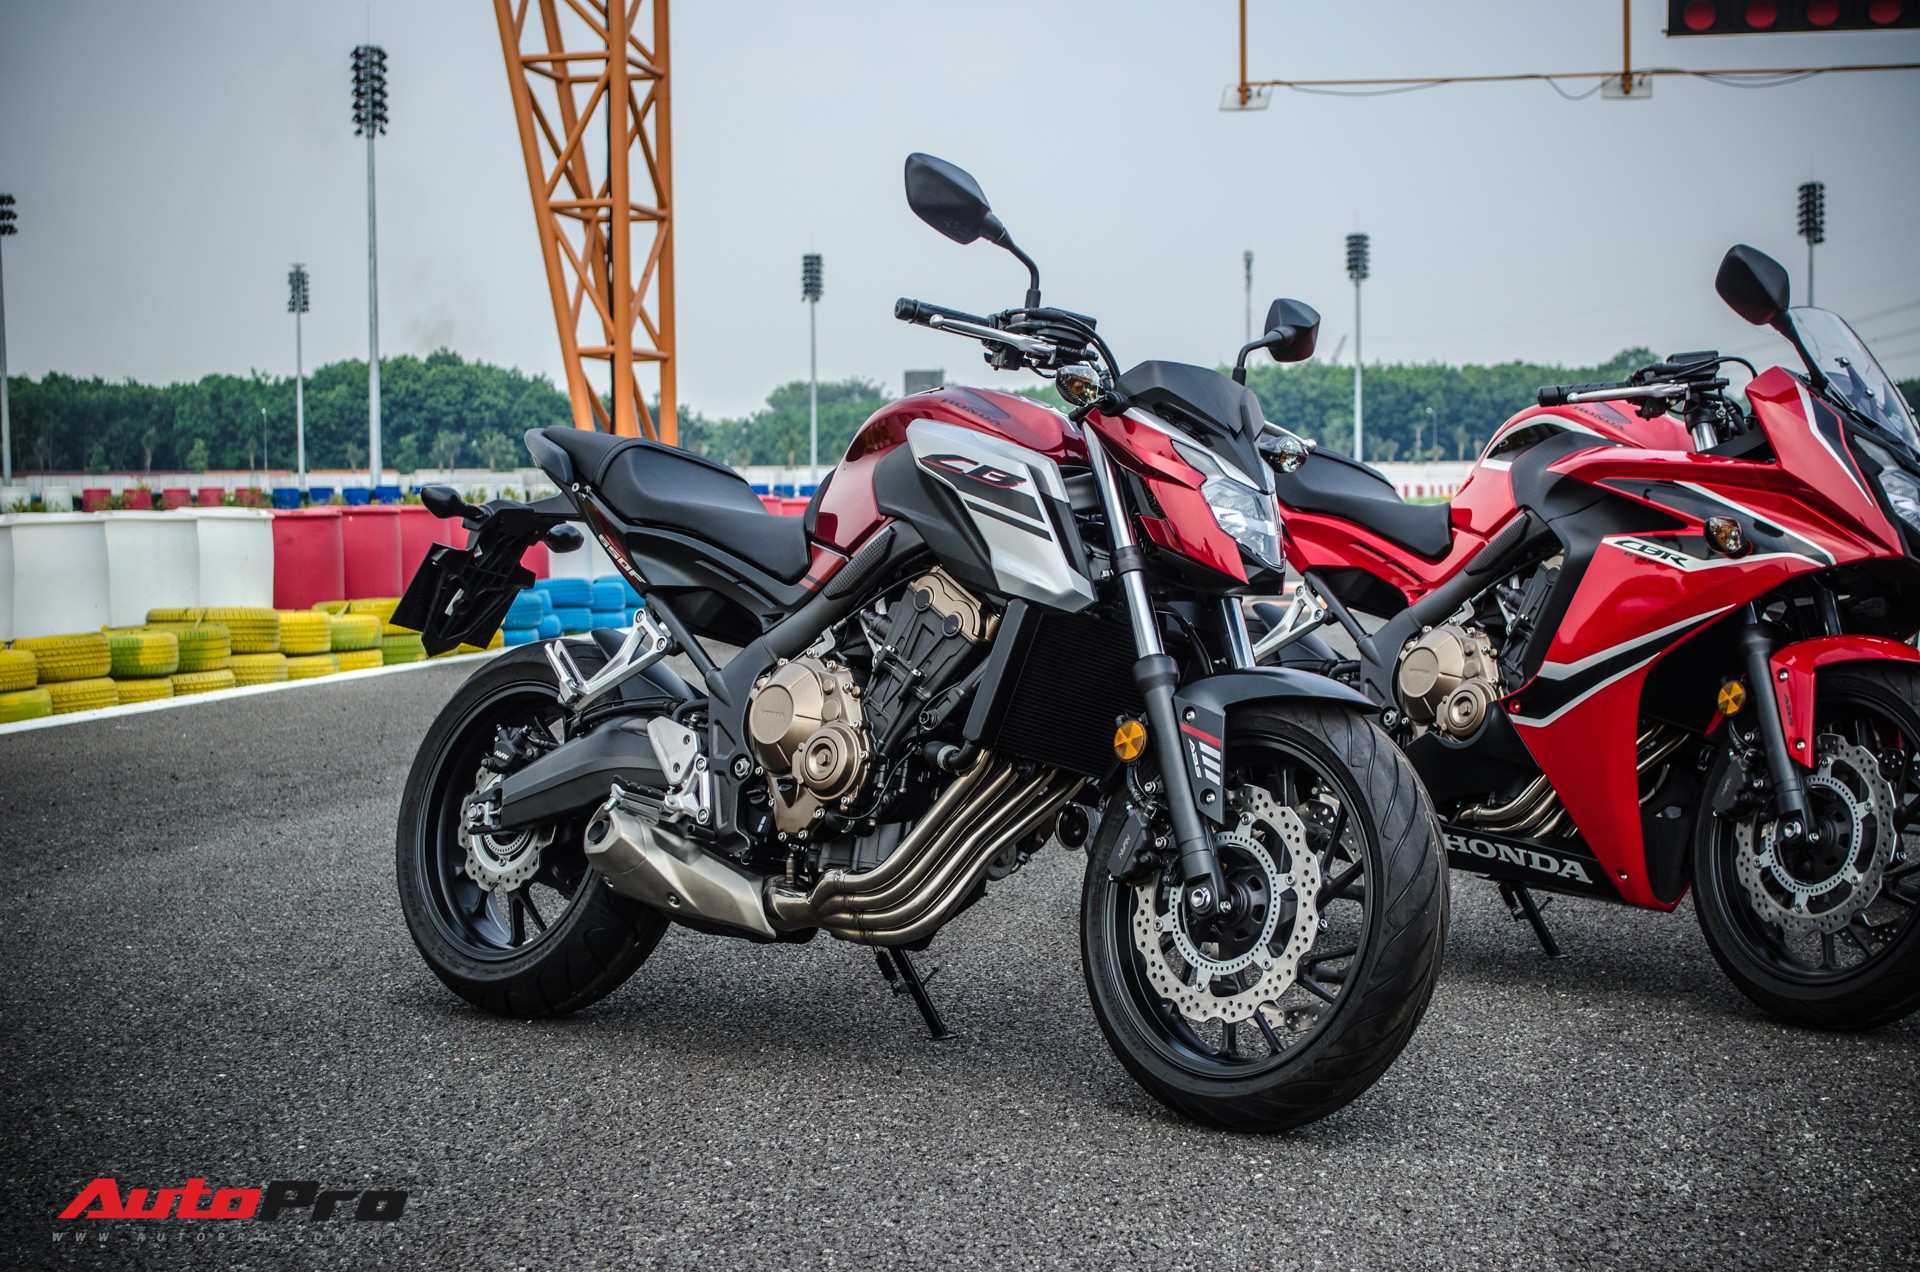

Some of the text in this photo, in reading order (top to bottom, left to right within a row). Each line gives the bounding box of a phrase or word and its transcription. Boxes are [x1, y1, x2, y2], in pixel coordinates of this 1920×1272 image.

[941, 398, 1001, 426] HONDA
[1573, 406, 1624, 431] HONDA
[918, 454, 1027, 489] CB
[599, 534, 647, 583] 650F
[1613, 540, 1688, 569] CBR
[1189, 738, 1202, 779] ABS
[1443, 833, 1593, 884] HONDA
